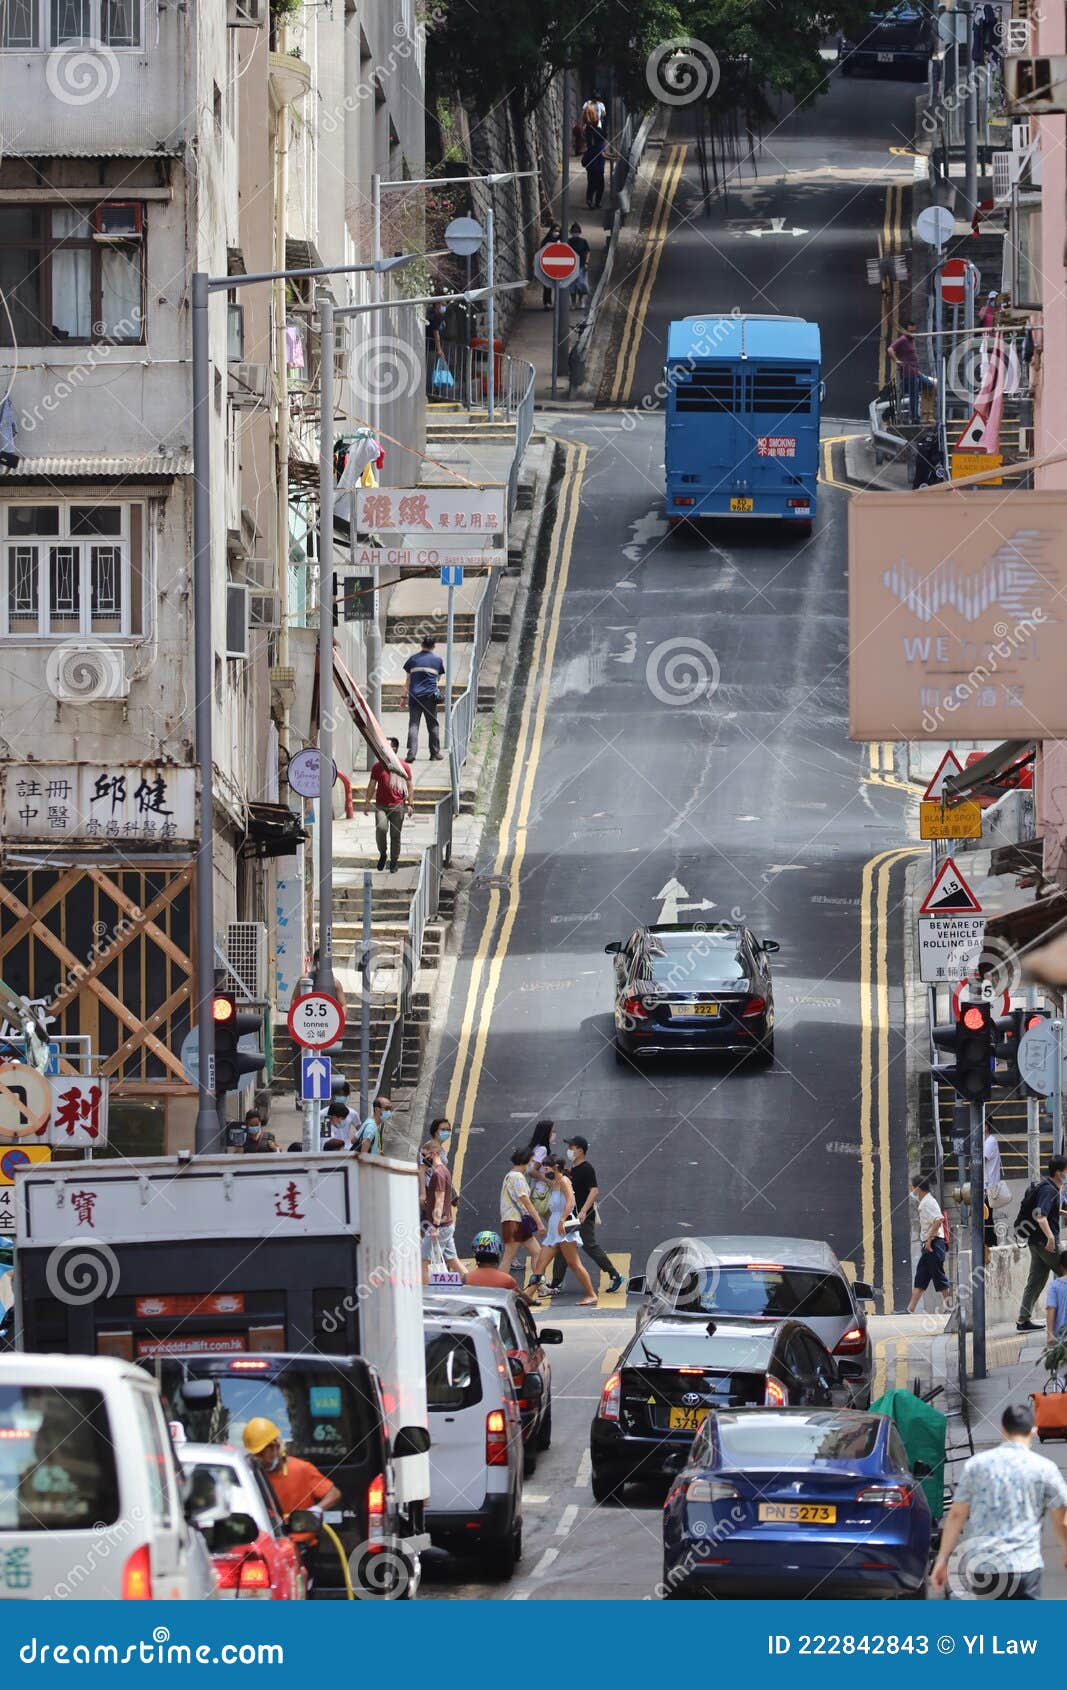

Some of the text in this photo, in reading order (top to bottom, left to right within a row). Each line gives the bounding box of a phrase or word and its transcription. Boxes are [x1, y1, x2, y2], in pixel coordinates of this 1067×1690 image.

[769, 437, 796, 448] SMOKING
[361, 495, 433, 530] 雅緻
[360, 550, 381, 564] AH
[387, 550, 411, 564] CHI
[902, 636, 950, 663] WE
[16, 780, 72, 799] 註冊
[90, 773, 174, 817] 邱健
[19, 804, 70, 829] 中醫
[942, 881, 959, 895] 1:5
[929, 920, 985, 930] BEWARE OF
[937, 930, 977, 939] VEHICLE
[923, 940, 965, 949] ROLLING
[304, 1003, 328, 1017] 5.5
[694, 1005, 711, 1014] 222
[50, 1086, 103, 1138] 利
[70, 1190, 97, 1228] 寶
[274, 1181, 305, 1219] 達
[433, 1273, 459, 1283] TAXI
[674, 1417, 700, 1429] 378
[765, 1506, 830, 1520] PN 5273
